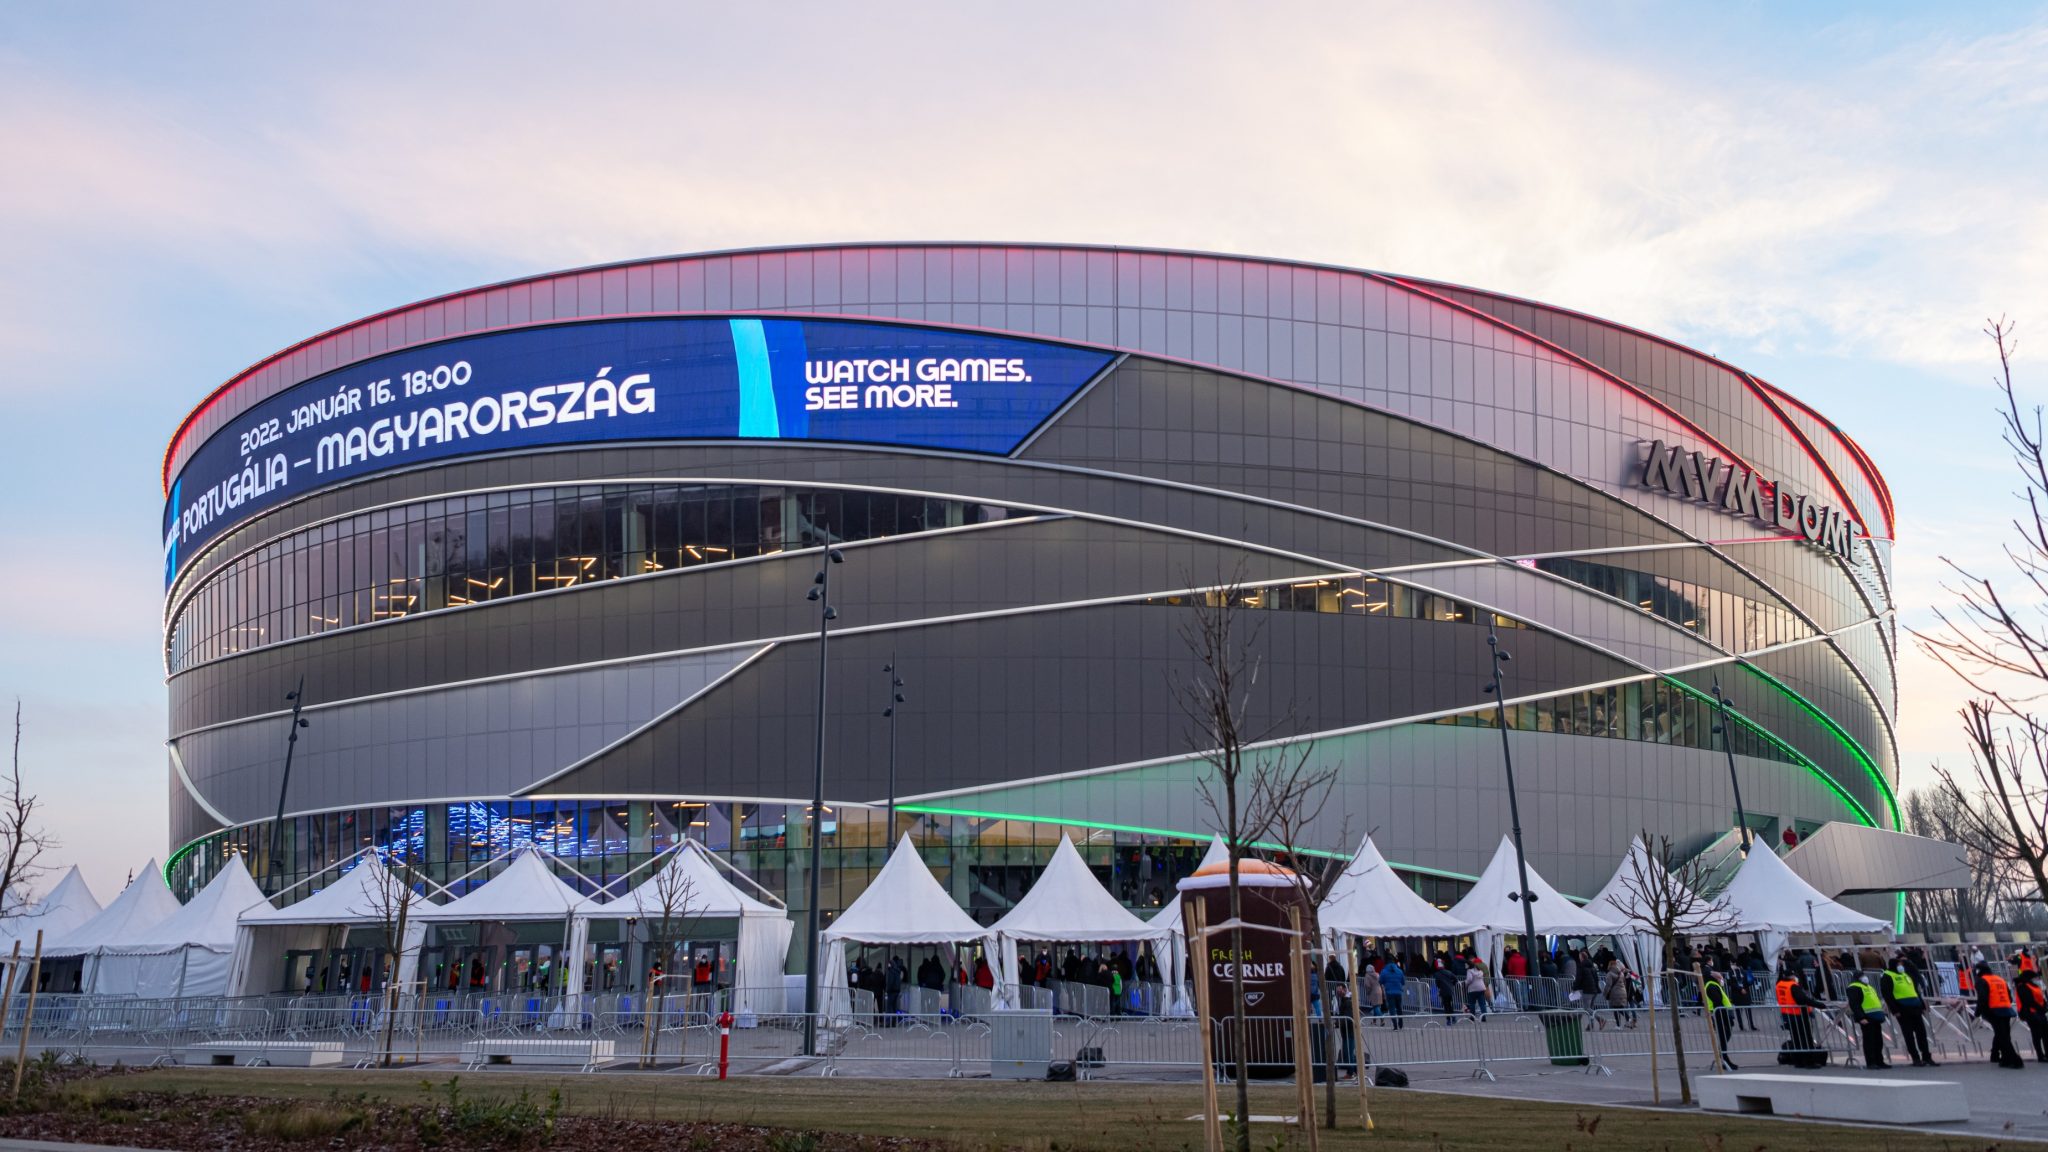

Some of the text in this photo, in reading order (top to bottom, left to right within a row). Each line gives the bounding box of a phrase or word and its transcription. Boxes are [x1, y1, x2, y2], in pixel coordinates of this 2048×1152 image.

[806, 358, 1032, 384] WATCH GAMES.
[806, 384, 958, 410] SEE MORE.
[240, 361, 472, 456] 2022. JANUÁR 16. 18:00
[183, 453, 287, 543] PORTUGÁLIA
[317, 366, 656, 474] MAGYARORSZÁG
[1641, 439, 1864, 567] MVM DOME
[1212, 949, 1252, 960] FREH
